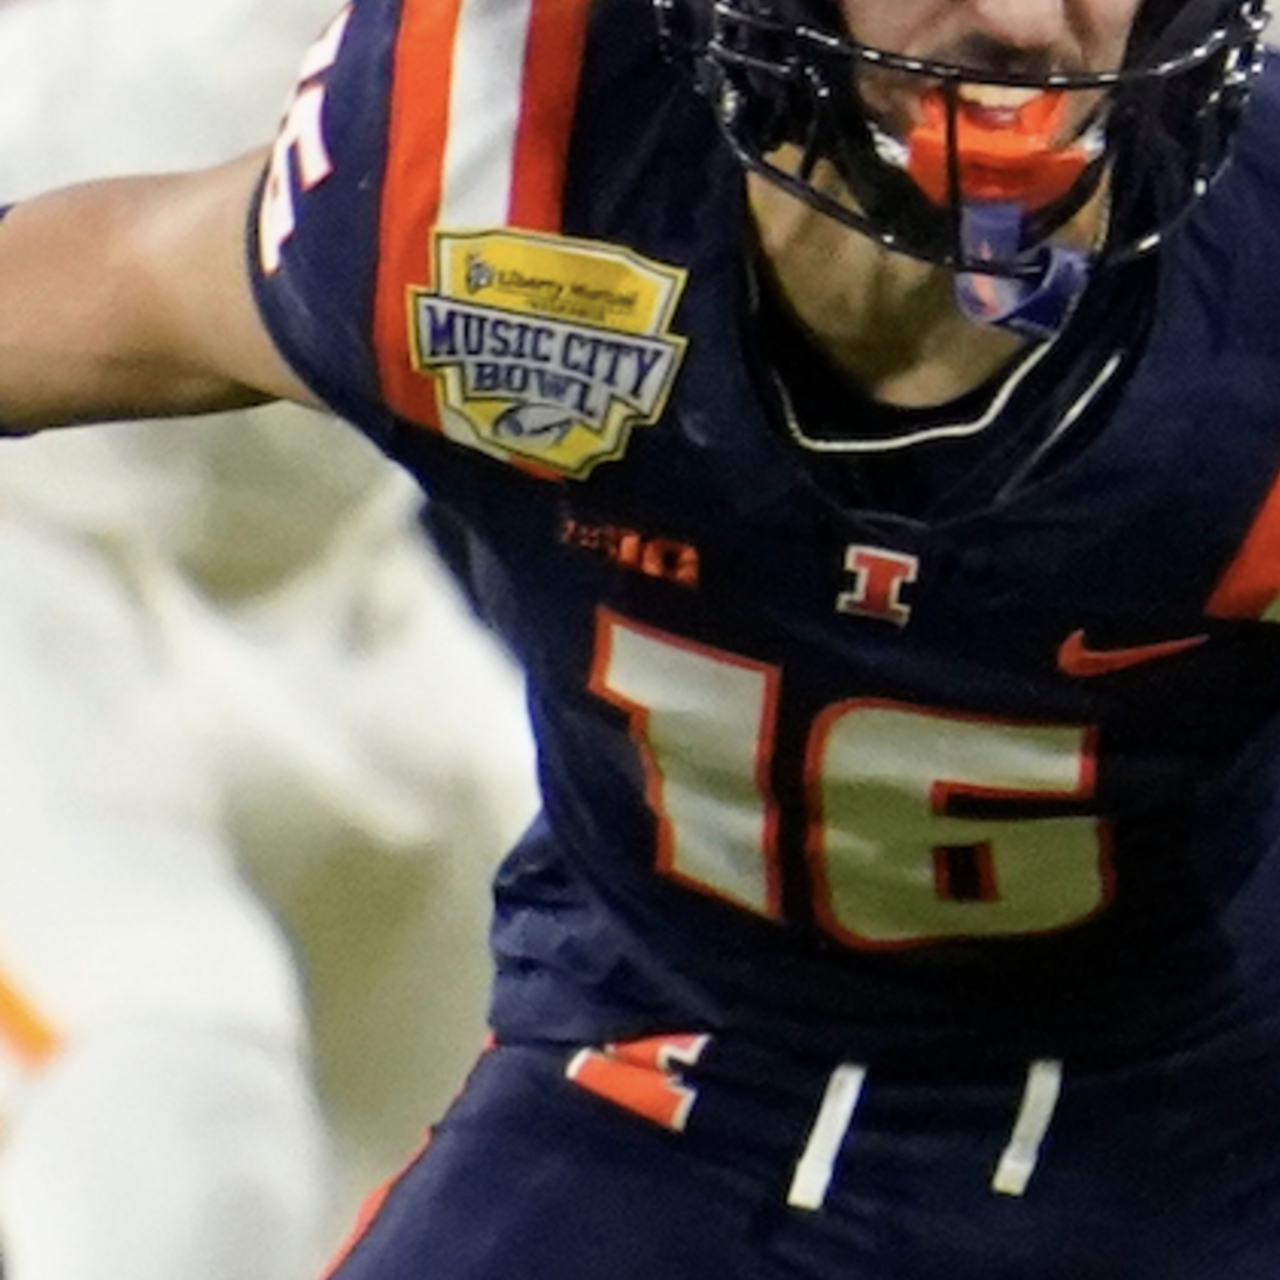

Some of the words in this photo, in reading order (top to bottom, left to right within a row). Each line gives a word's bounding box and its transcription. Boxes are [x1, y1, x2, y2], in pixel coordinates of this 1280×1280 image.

[424, 304, 554, 363] MUSIC
[561, 331, 664, 399] CITY
[474, 362, 596, 418] BOWL
[835, 542, 920, 628] I
[589, 603, 1115, 954] 16
